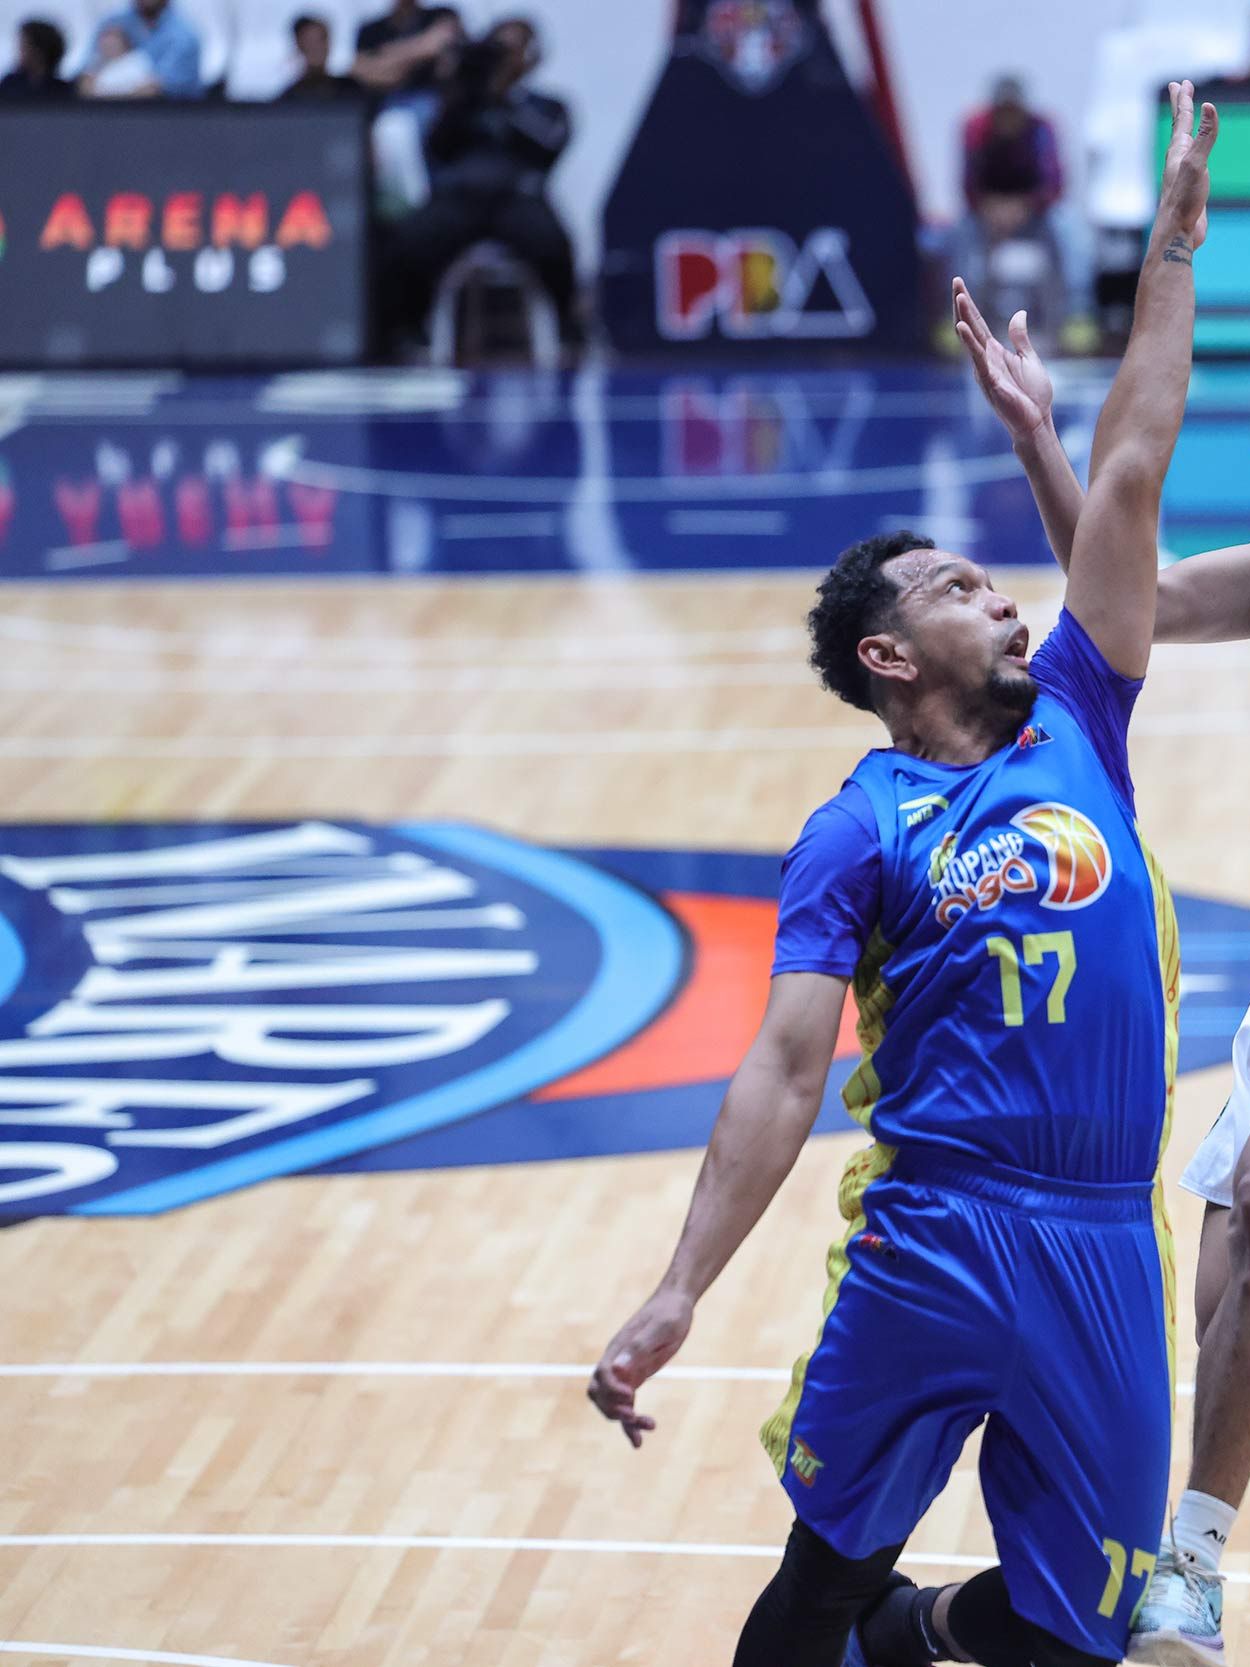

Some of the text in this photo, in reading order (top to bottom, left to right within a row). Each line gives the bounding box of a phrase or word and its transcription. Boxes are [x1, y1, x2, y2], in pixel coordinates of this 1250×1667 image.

[39, 190, 333, 250] ARENA
[86, 246, 287, 293] PLUS
[655, 227, 876, 340] PBA
[987, 930, 1077, 1027] 17
[1097, 1537, 1158, 1630] 17
